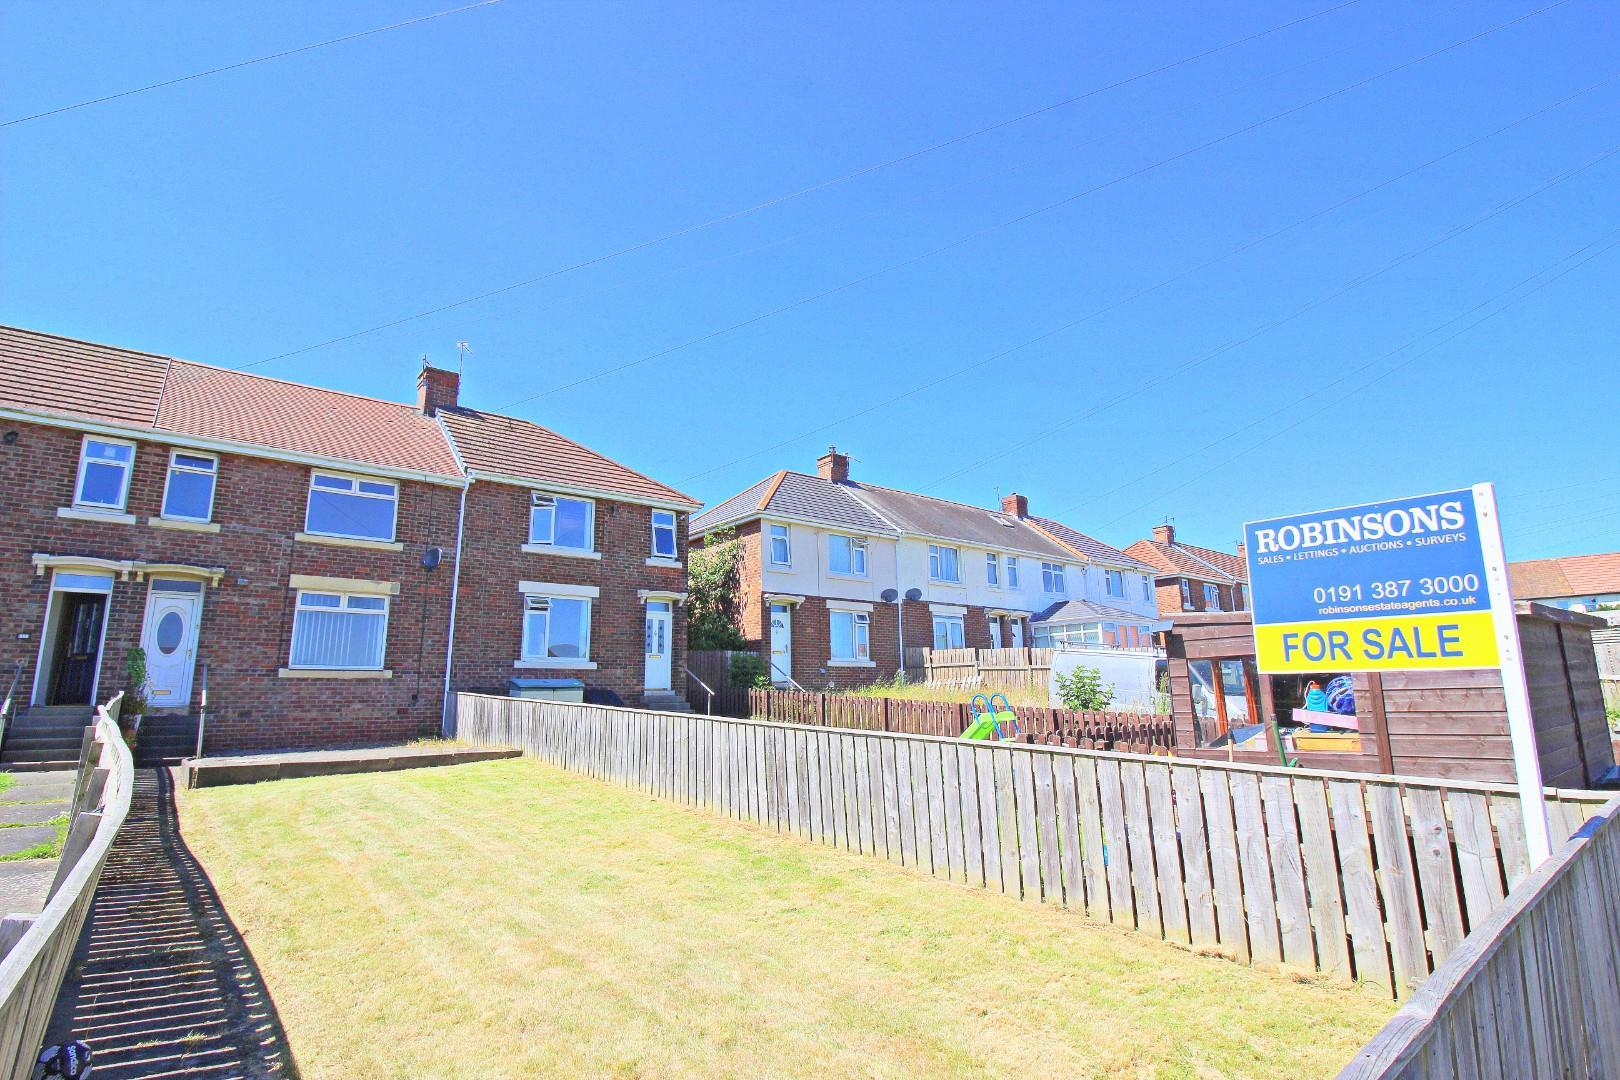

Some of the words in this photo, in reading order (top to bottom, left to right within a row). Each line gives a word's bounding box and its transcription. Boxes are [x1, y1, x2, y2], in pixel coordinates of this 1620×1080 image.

[1254, 501, 1464, 554] ROBINSONS
[1257, 554, 1284, 565] SALES
[1293, 547, 1339, 561] LETTINGS
[1349, 540, 1404, 555] AUCTIONS
[1415, 532, 1467, 547] SURVEYS
[1313, 583, 1362, 604] 0191
[1370, 579, 1412, 599] 387
[1419, 573, 1479, 596] 3000
[1318, 595, 1477, 615] robinsonsestateagents.co.uk
[1282, 630, 1353, 662] FOR
[1362, 624, 1464, 660] SALE
